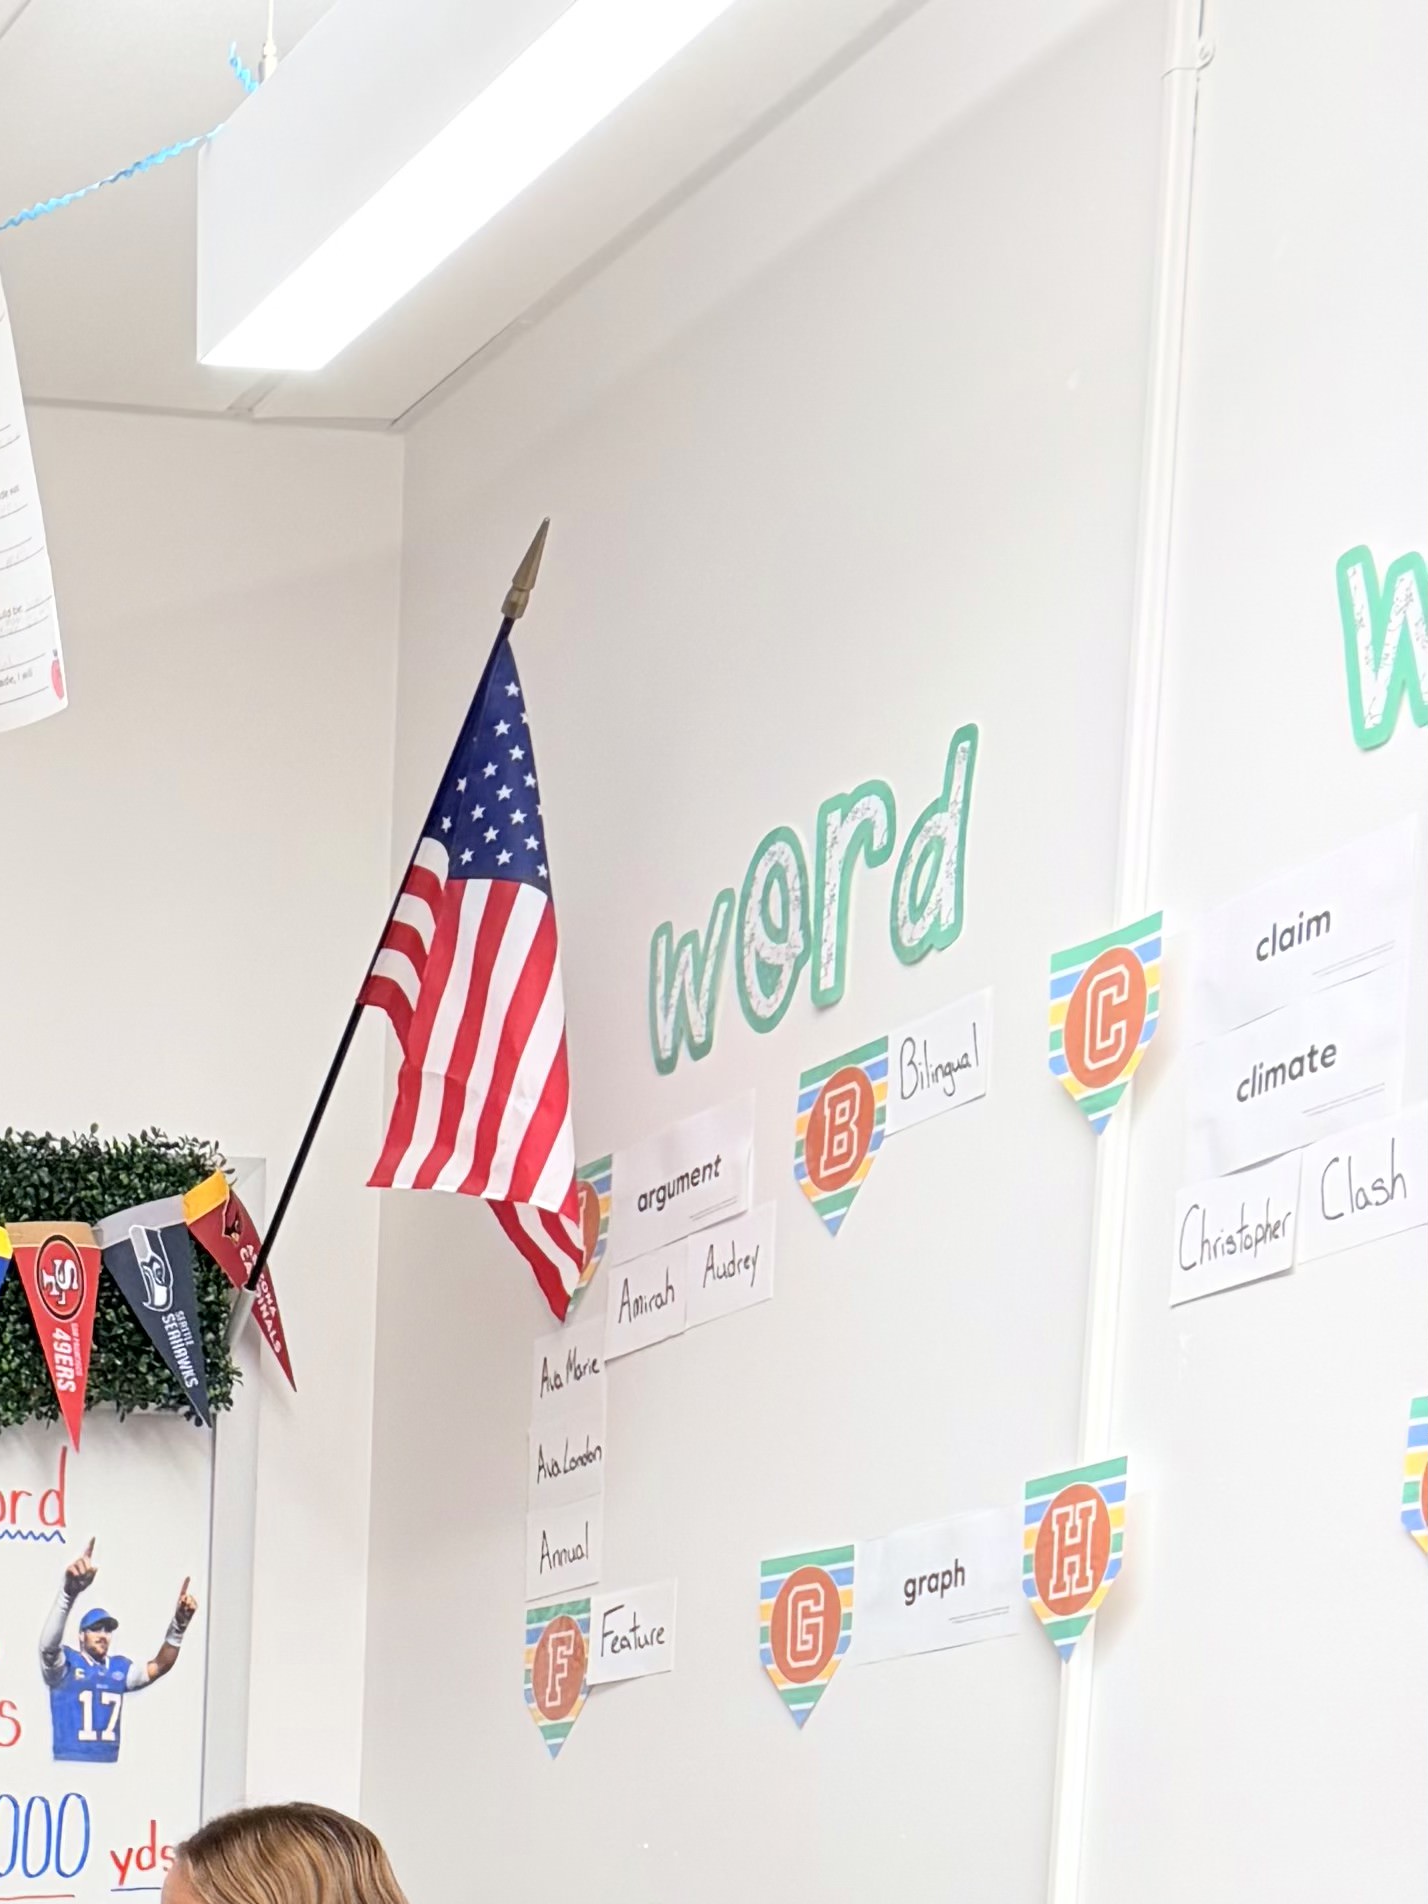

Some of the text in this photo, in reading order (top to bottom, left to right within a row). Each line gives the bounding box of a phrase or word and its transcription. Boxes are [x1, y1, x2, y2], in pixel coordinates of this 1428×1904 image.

[648, 722, 980, 1078] word
[1255, 906, 1332, 965] claim
[897, 1022, 981, 1104] Bilingual
[1234, 1039, 1339, 1106] climate
[637, 1154, 723, 1214] argument
[1318, 1137, 1409, 1227] Clash
[702, 1243, 761, 1290] Audrey
[1177, 1198, 1293, 1276] Christopher
[617, 1267, 676, 1325] Amirah
[51, 1326, 77, 1394] 49ERS
[161, 1312, 200, 1390] SEAHAWKS
[539, 1519, 591, 1576] Annual
[902, 1558, 967, 1607] graph
[600, 1604, 668, 1658] Feature
[77, 1689, 123, 1742] 17
